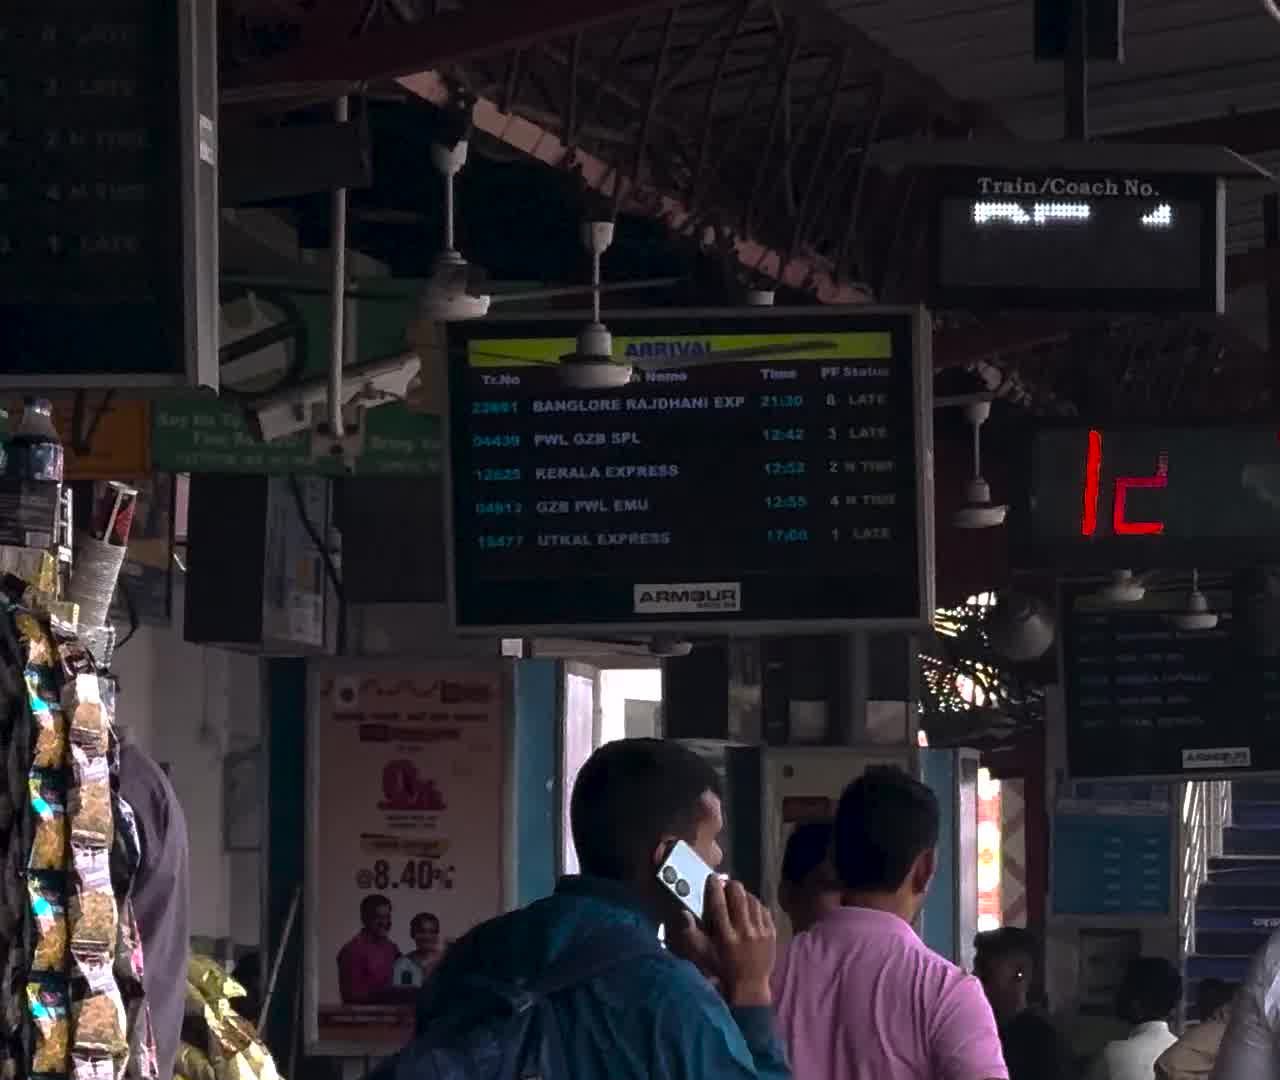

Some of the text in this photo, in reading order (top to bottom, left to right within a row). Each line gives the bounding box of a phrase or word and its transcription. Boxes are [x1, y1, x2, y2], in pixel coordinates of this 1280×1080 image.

[977, 176, 1161, 197] Train/Coach No.
[531, 398, 624, 413] BANGLORE
[626, 396, 708, 411] RAJDHANI
[714, 395, 745, 409] EXP
[611, 431, 640, 445] SPL
[535, 465, 600, 480] KERALA
[605, 464, 679, 478] EXPRESS
[613, 498, 648, 512] EMU
[597, 531, 672, 546] EXPRESS
[639, 589, 737, 603] ARMOUR
